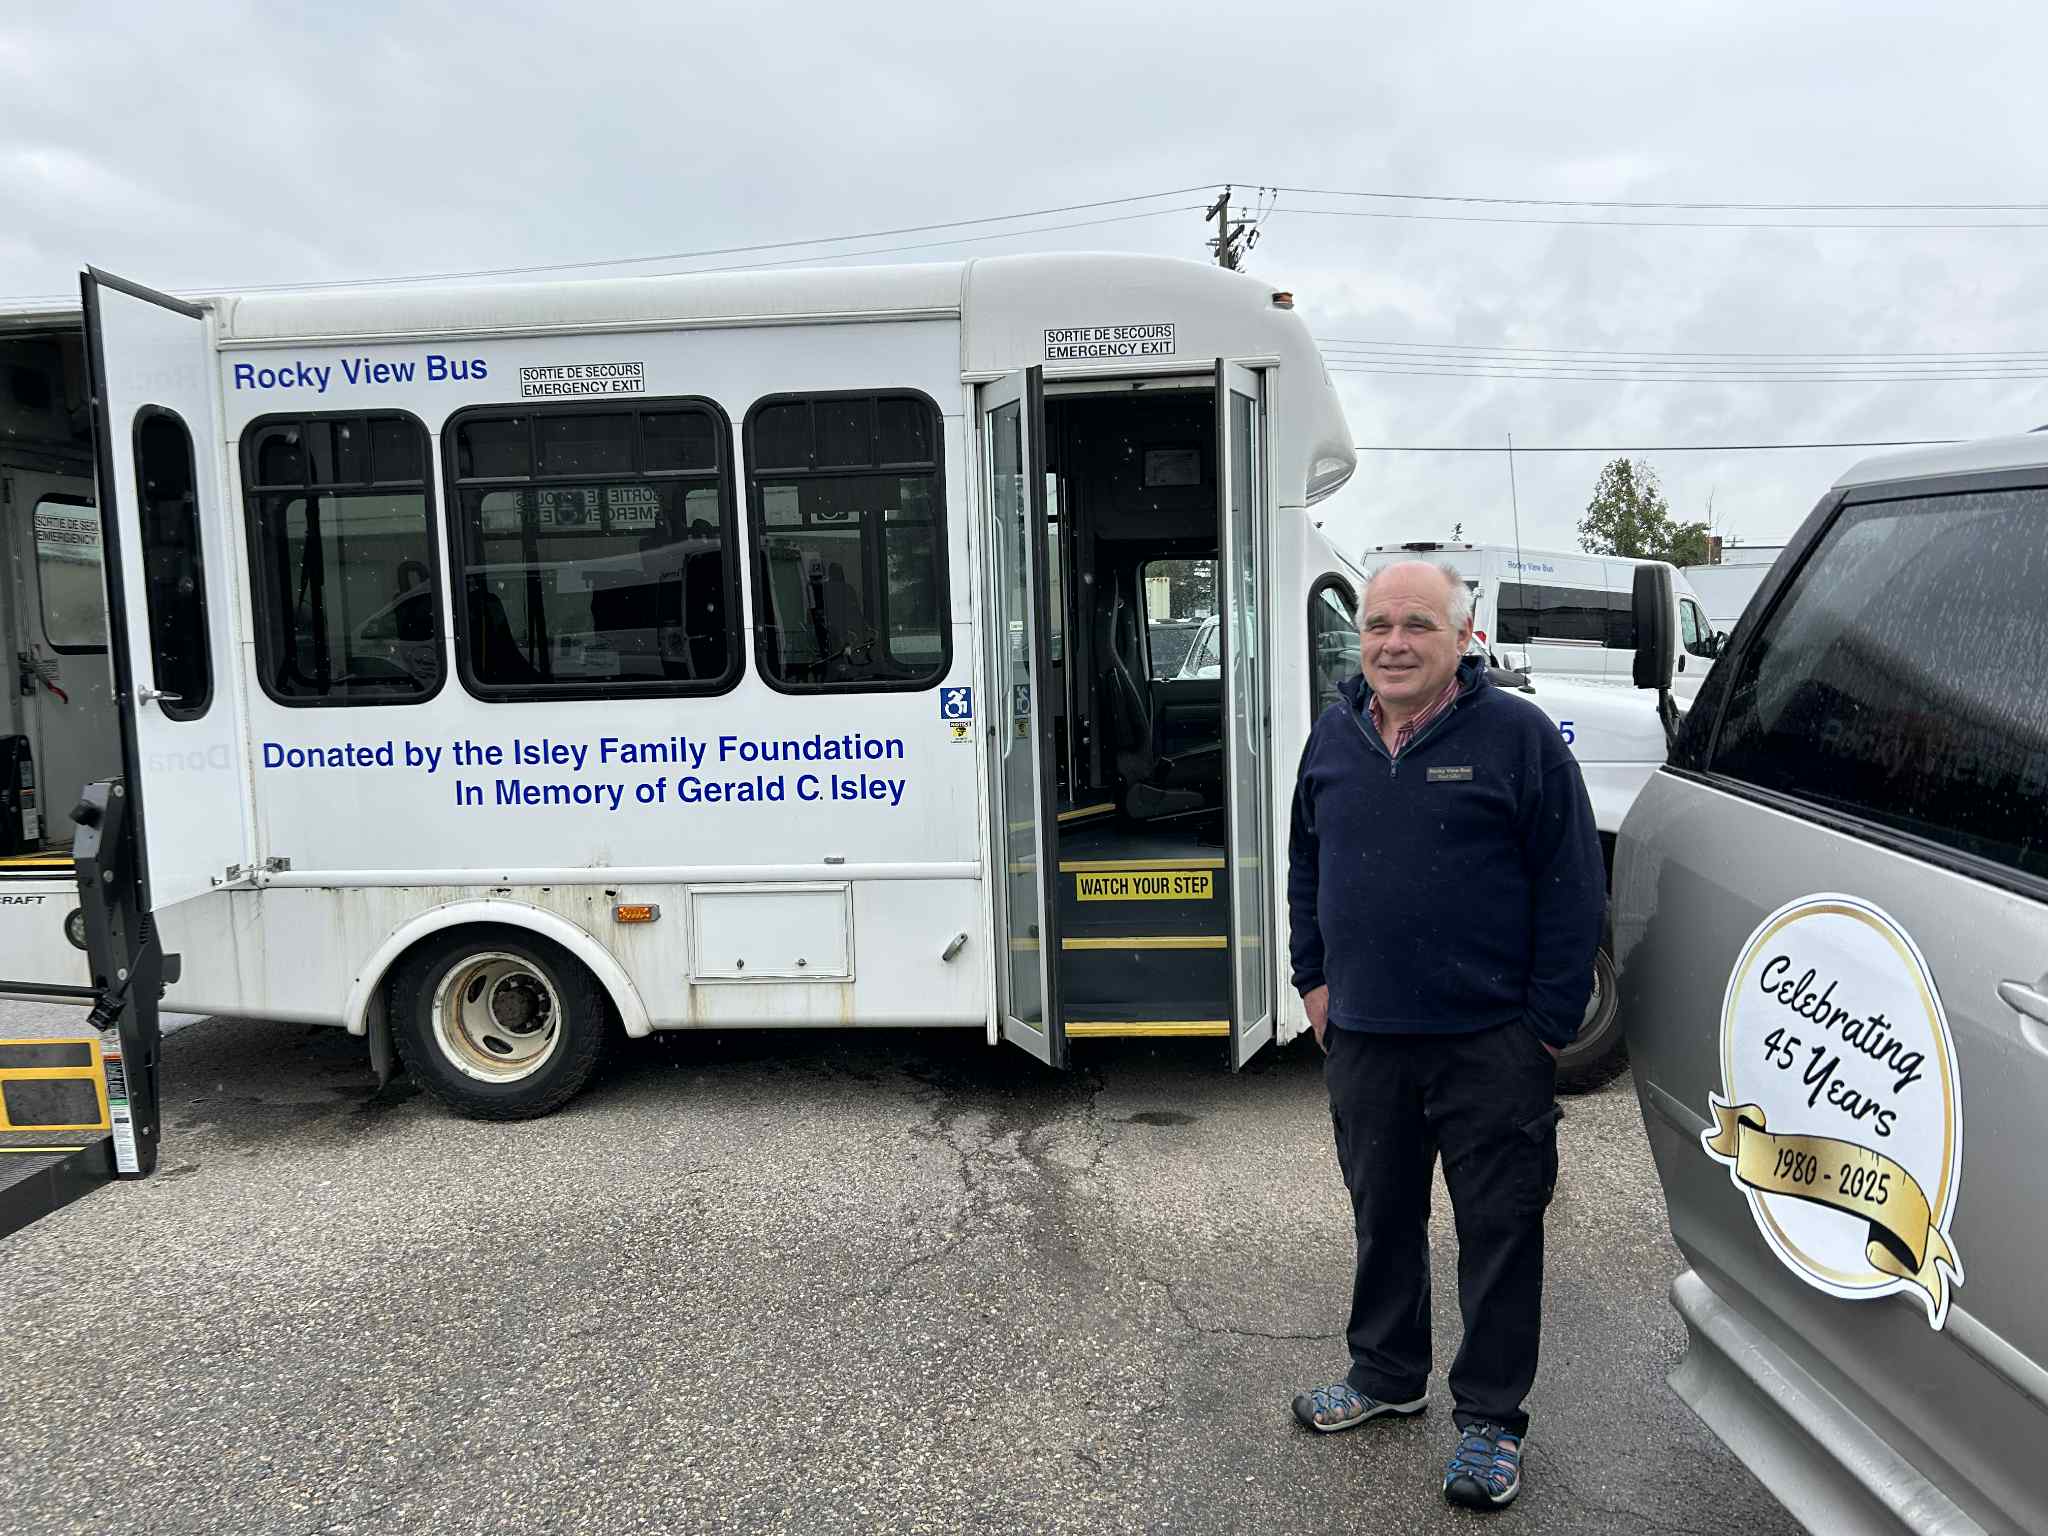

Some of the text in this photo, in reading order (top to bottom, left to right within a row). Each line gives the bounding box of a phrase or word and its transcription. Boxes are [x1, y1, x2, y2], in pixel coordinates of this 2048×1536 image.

[1047, 326, 1172, 343] SORTIE DE SECOURS
[1047, 341, 1172, 358] EMERGENCY EXIT
[234, 361, 331, 393] Rocky
[341, 358, 415, 385] View
[426, 355, 488, 382] Bus
[523, 364, 641, 380] SORTIE DE SECOURS
[524, 379, 641, 395] EMERGENCY EXIT
[1560, 721, 1575, 745] 5
[263, 734, 905, 773] Donated by the Isley Family Foundation
[456, 773, 906, 811] In Memory of Gerald C. Isley
[1080, 876, 1209, 895] WATCH YOUR STEP
[0, 896, 46, 905] RAFT
[1760, 955, 1926, 1094] Celebrating
[1764, 1027, 1897, 1138] 45 Years
[1773, 1148, 1818, 1186] 1980
[1838, 1163, 1891, 1206] 2025
